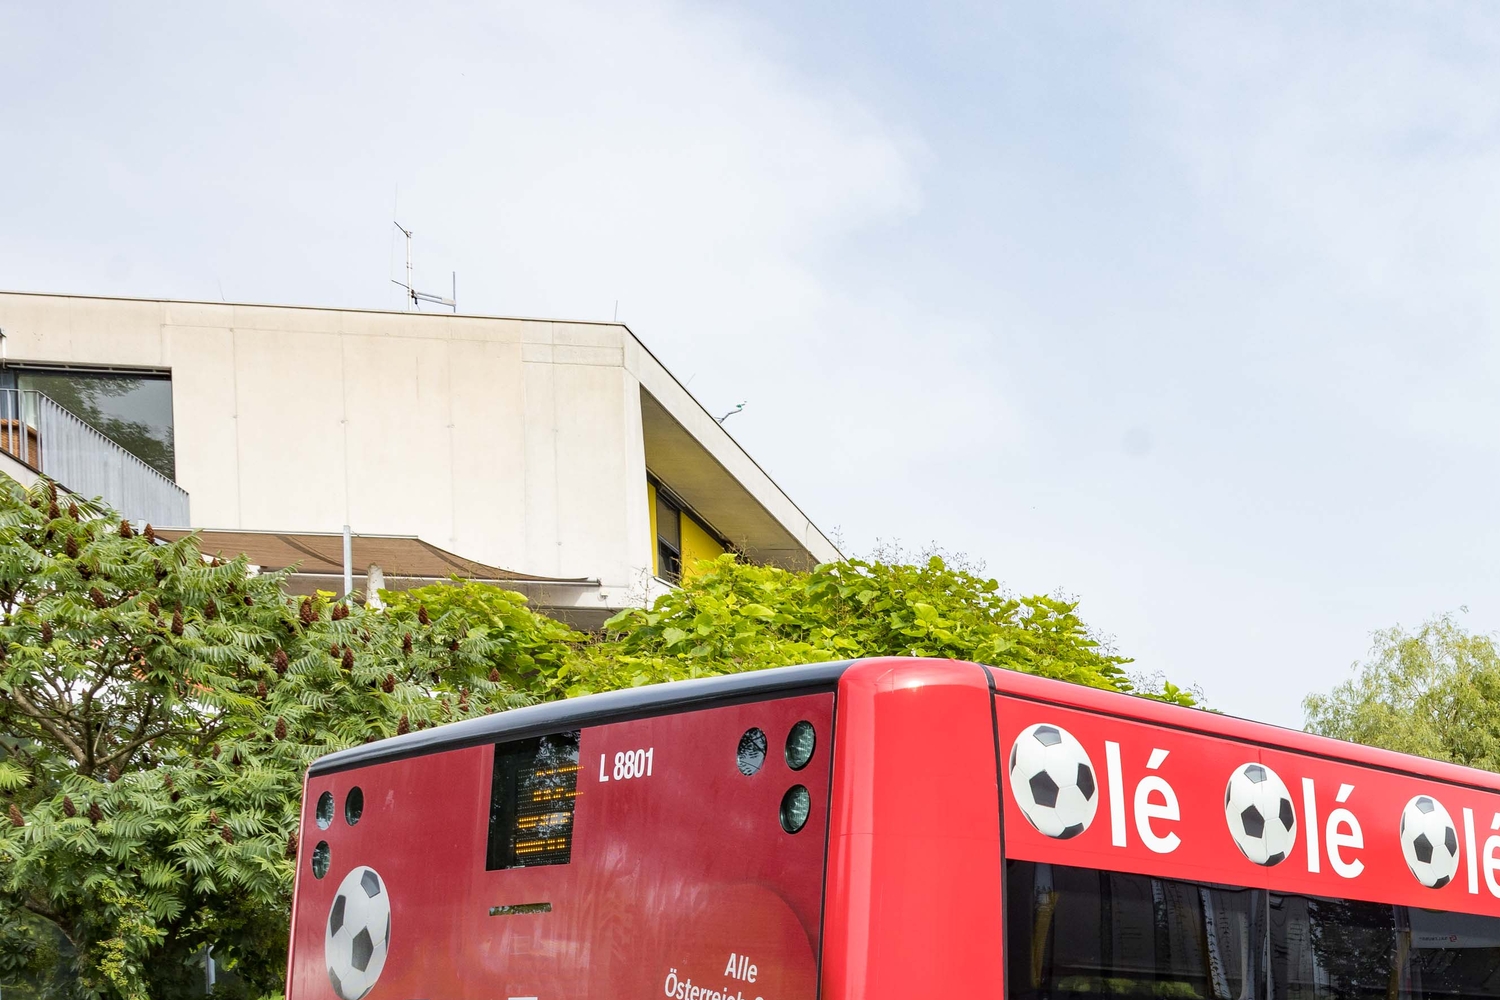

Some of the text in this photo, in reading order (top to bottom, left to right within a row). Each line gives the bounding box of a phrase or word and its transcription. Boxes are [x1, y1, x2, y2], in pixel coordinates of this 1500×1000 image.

[599, 747, 654, 782] L 8801
[725, 953, 758, 983] Alle
